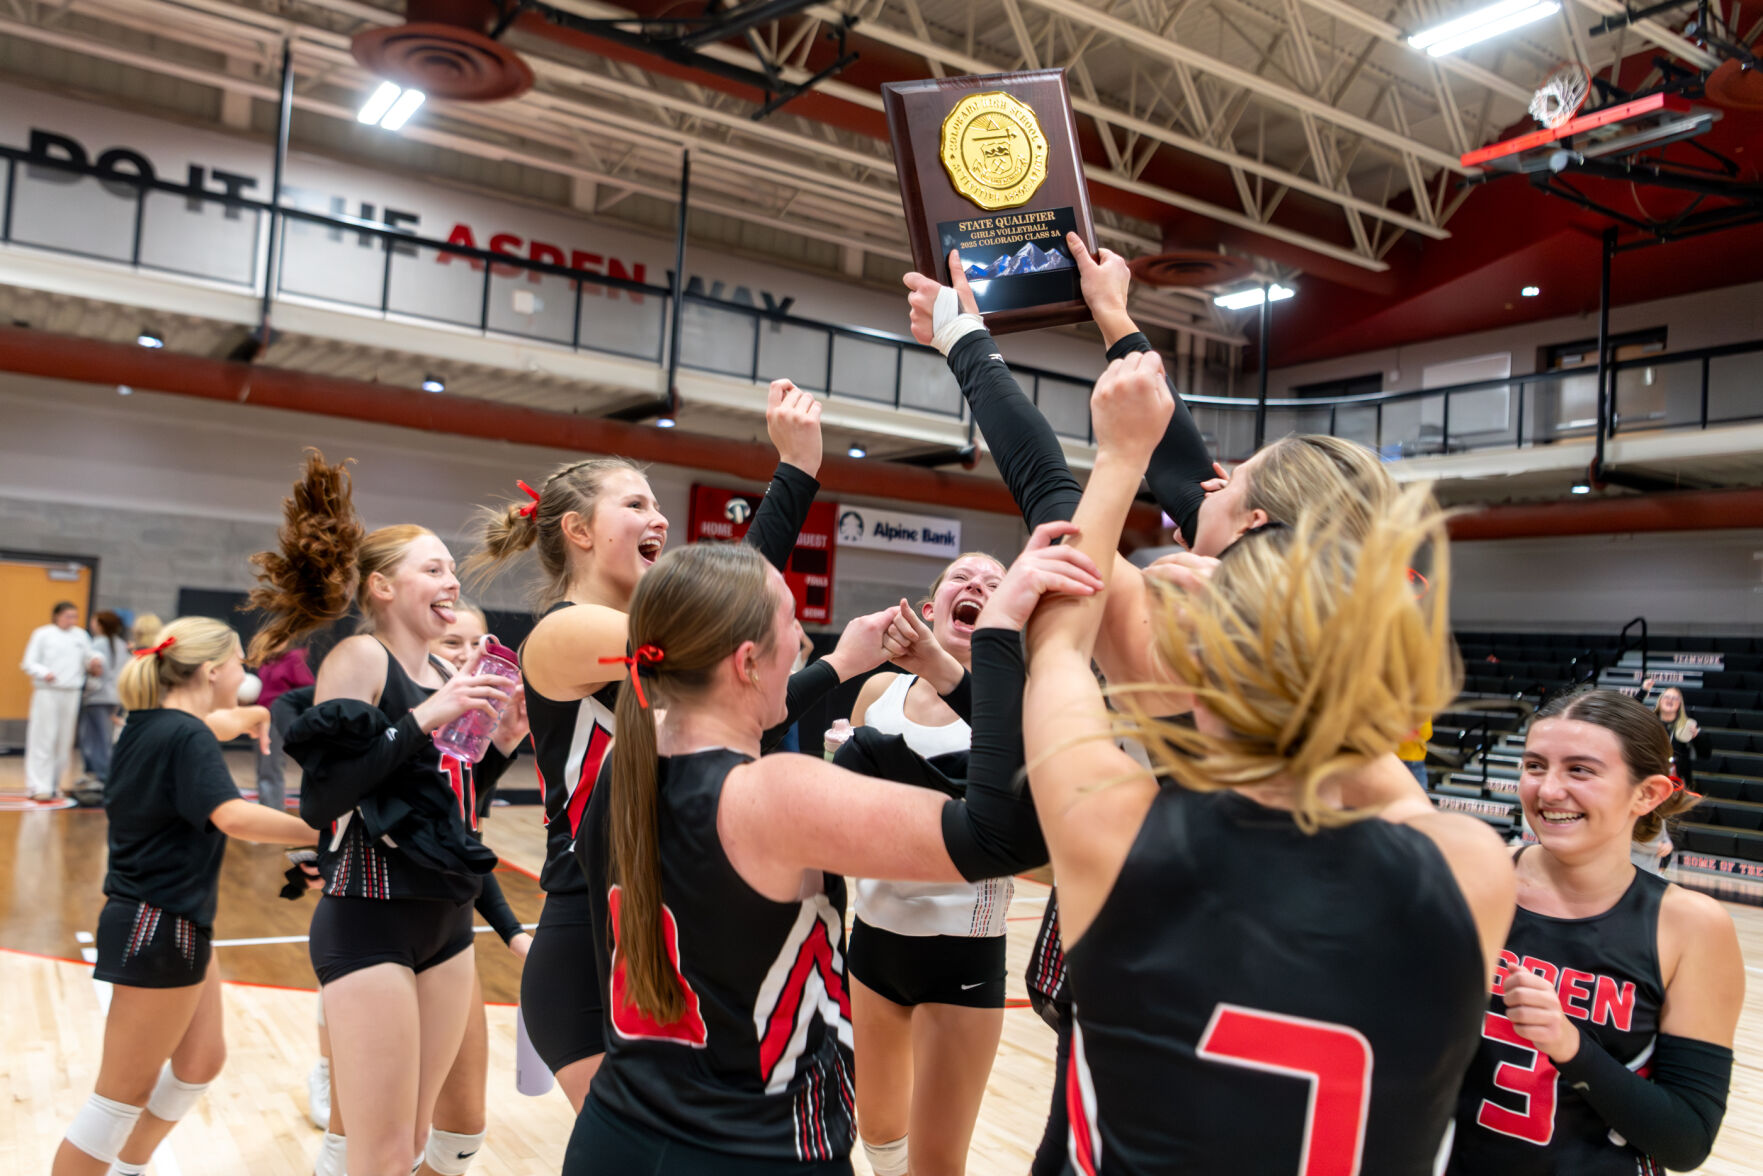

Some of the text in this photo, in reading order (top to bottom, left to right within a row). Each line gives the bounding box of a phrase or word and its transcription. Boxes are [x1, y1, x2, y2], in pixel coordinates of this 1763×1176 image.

[1010, 106, 1039, 142] SCHOOL
[27, 127, 155, 198] DO
[186, 162, 257, 221] IT
[436, 223, 647, 305] ASPEN
[959, 211, 1056, 232] STATE QUALIFIER
[960, 230, 1062, 249] 2025 COLORADO CLASS 3A
[970, 223, 1049, 240] GIRLS VOLLEYBALL
[701, 521, 734, 538] HOME
[873, 522, 956, 547] Alpine Bank
[1673, 654, 1721, 665] TEAMWORK
[1683, 855, 1763, 878] HOME OF THE
[1491, 949, 1637, 1033] SPEN
[1195, 1002, 1374, 1176] 7
[1476, 1010, 1561, 1146] 3
